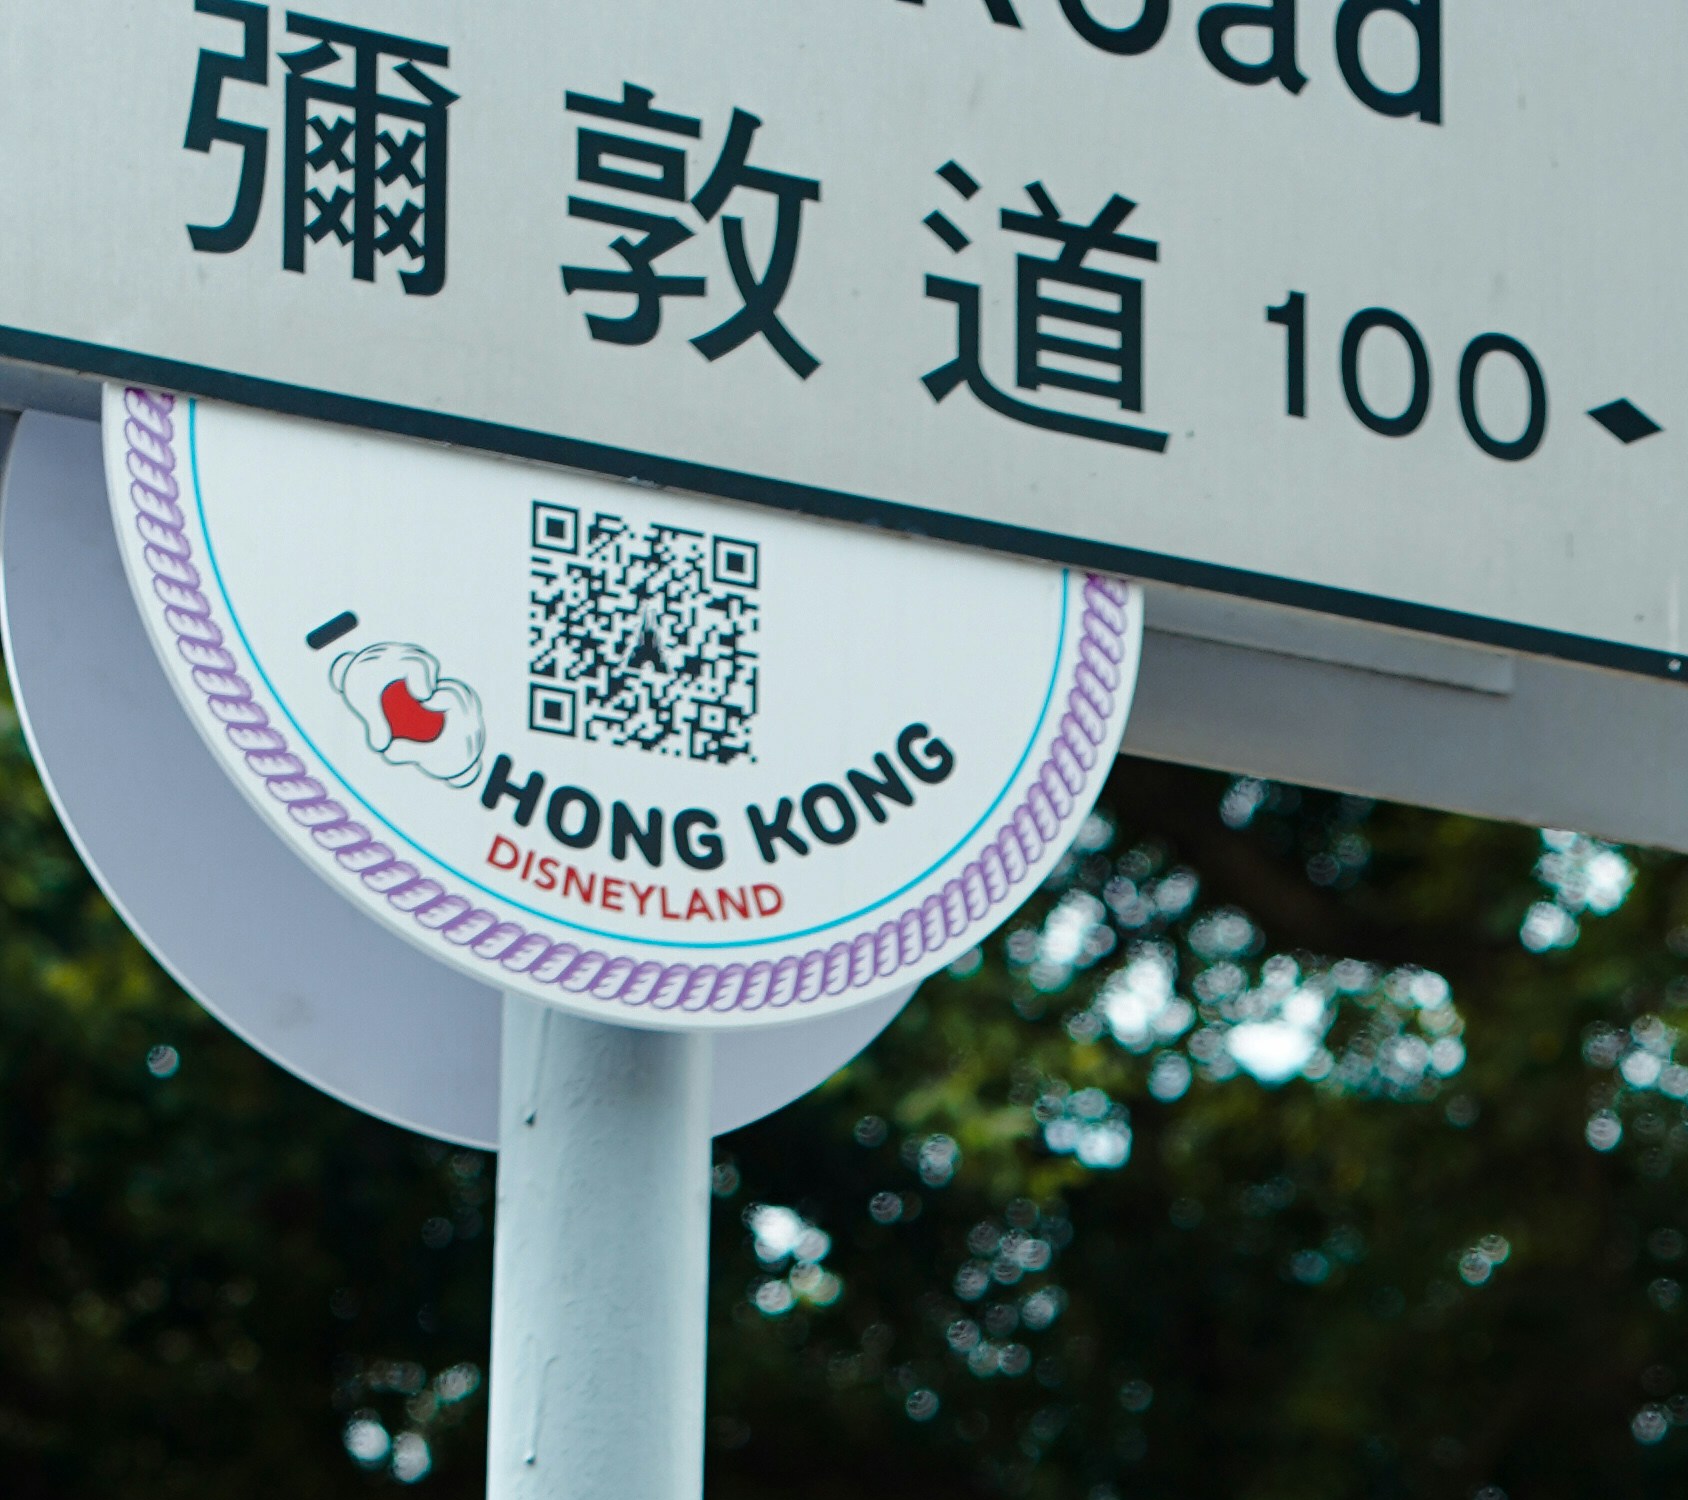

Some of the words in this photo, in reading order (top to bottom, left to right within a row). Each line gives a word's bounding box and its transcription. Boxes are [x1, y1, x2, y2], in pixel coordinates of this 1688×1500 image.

[897, 0, 1443, 126] ad
[183, 0, 1171, 454] 彌敦道
[1265, 290, 1549, 463] 100
[305, 610, 359, 651] I
[480, 753, 726, 872] HONG
[745, 721, 955, 865] KONG
[486, 834, 784, 921] DISNEYLAND
